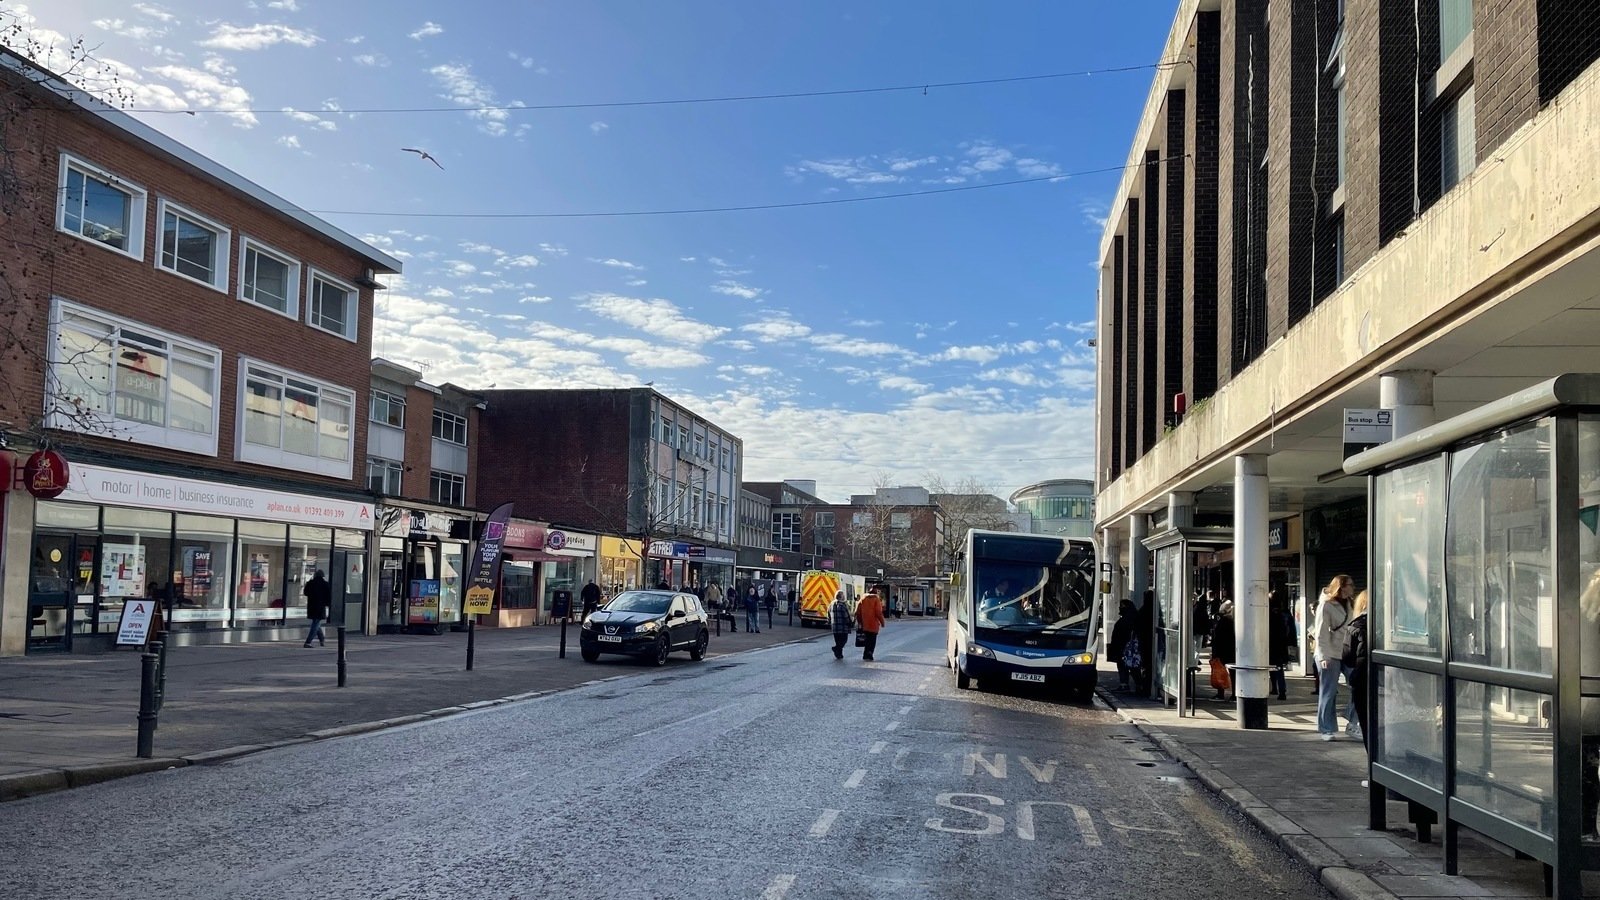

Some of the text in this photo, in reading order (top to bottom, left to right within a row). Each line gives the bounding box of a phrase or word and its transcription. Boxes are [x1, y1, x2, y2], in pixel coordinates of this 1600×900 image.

[101, 480, 254, 509] motor home business insurance
[266, 501, 301, 514] aplan.co.uk
[304, 506, 322, 516] 01392
[195, 552, 211, 560] SAVE
[648, 541, 674, 556] ETFRED
